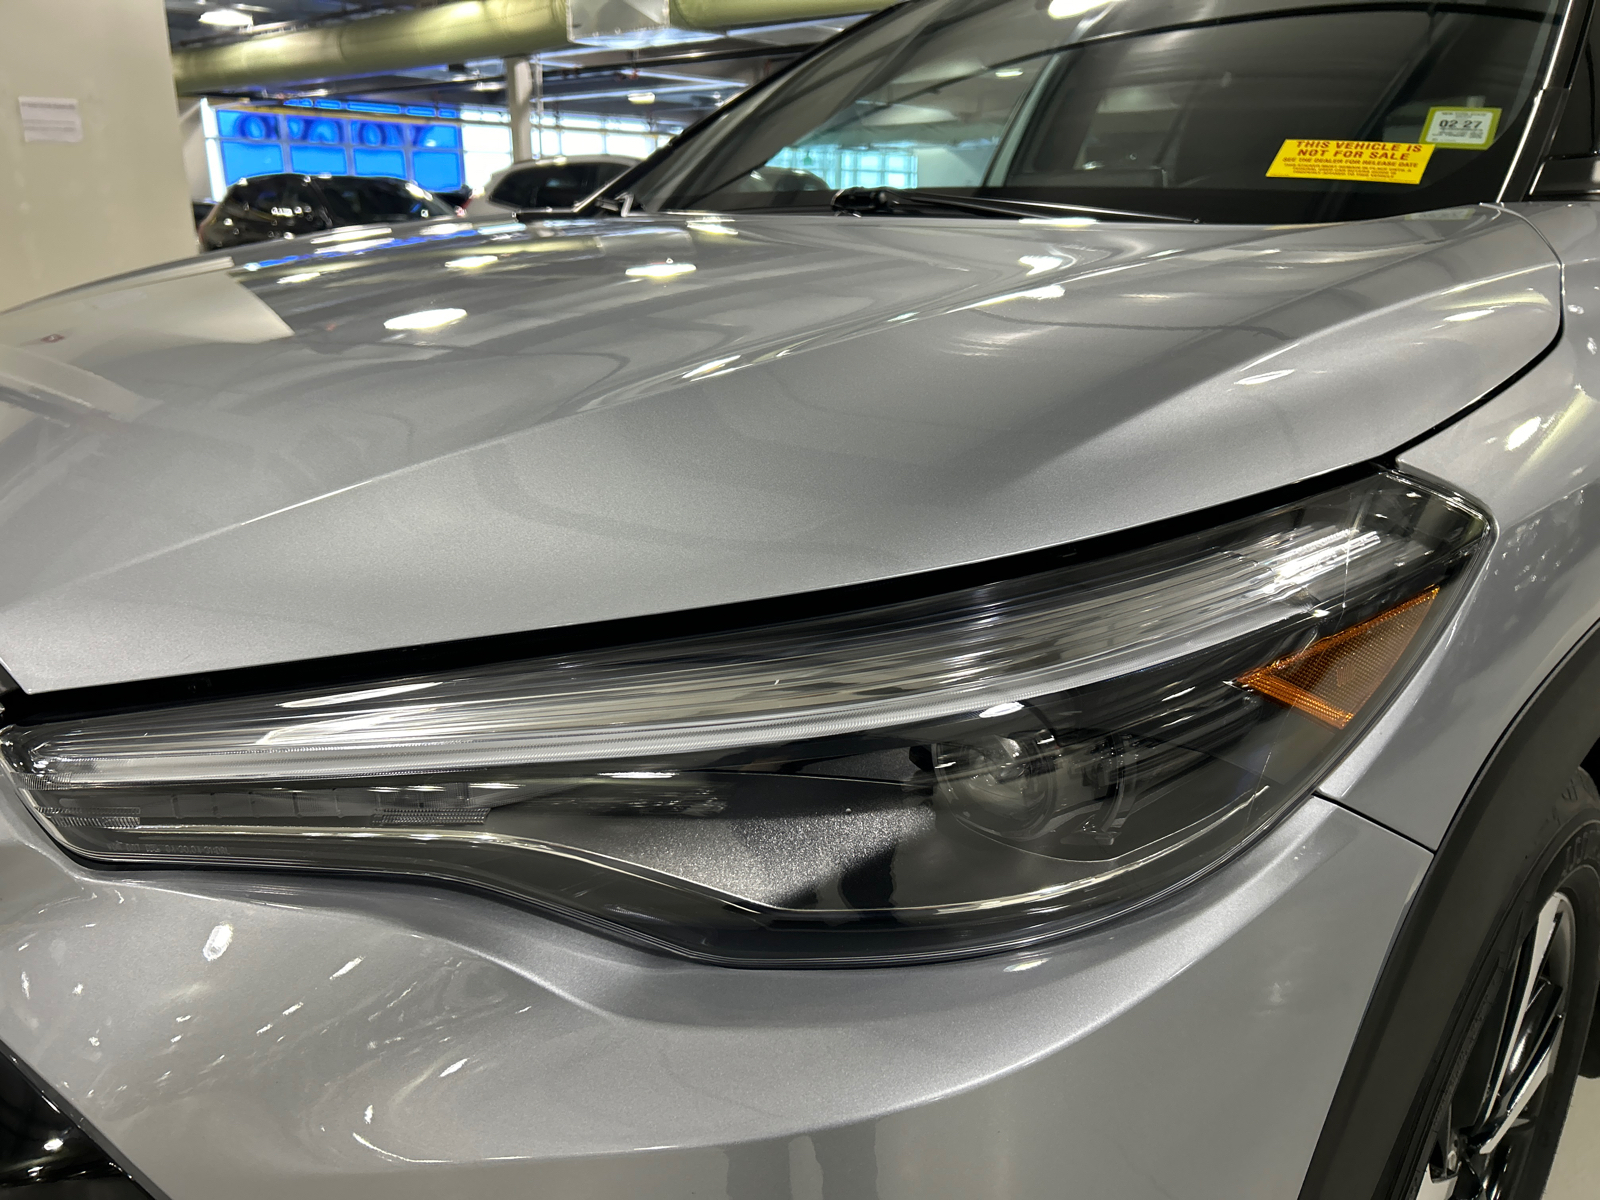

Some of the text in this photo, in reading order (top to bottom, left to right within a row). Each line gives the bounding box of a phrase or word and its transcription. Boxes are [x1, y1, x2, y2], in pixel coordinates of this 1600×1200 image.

[1439, 119, 1483, 128] 02 27
[1296, 140, 1423, 153] THIS VEHICLE IS
[1297, 149, 1411, 161] NOT FOR SALE
